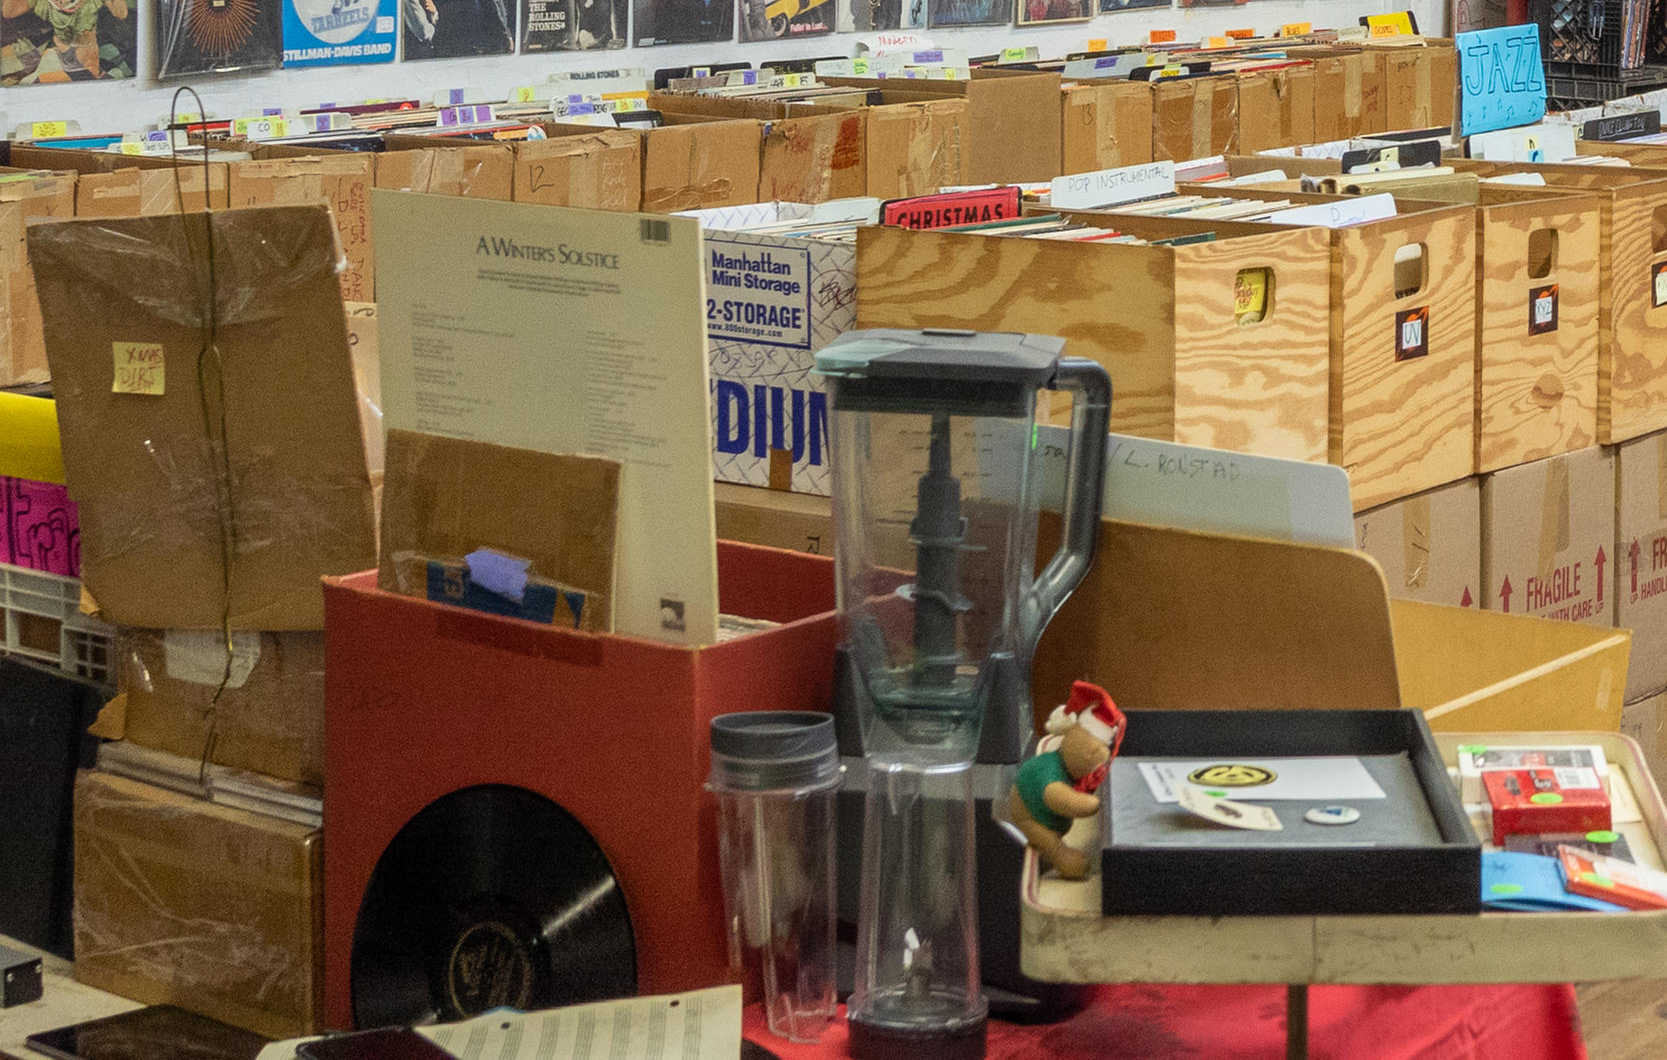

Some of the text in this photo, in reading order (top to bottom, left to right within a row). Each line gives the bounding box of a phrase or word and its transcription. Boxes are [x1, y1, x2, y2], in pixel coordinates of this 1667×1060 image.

[529, 3, 546, 12] THE
[529, 12, 565, 22] ROLLING
[284, 43, 391, 62] STILLMAN-DAVIS BAND
[1464, 36, 1542, 96] JAZZ
[530, 164, 554, 192] 12
[1068, 166, 1169, 194] POP INSTRUMENTAL
[898, 202, 1004, 229] CHRISTMAS
[476, 238, 620, 269] A WINTER'S SOLSTICE
[712, 249, 791, 276] Manhattan
[712, 270, 800, 296] Mini Storage
[707, 298, 802, 329] 2-STORAGE
[1403, 319, 1422, 347] UV
[1526, 562, 1581, 612] FRAGILE
[1572, 598, 1593, 621] CARE
